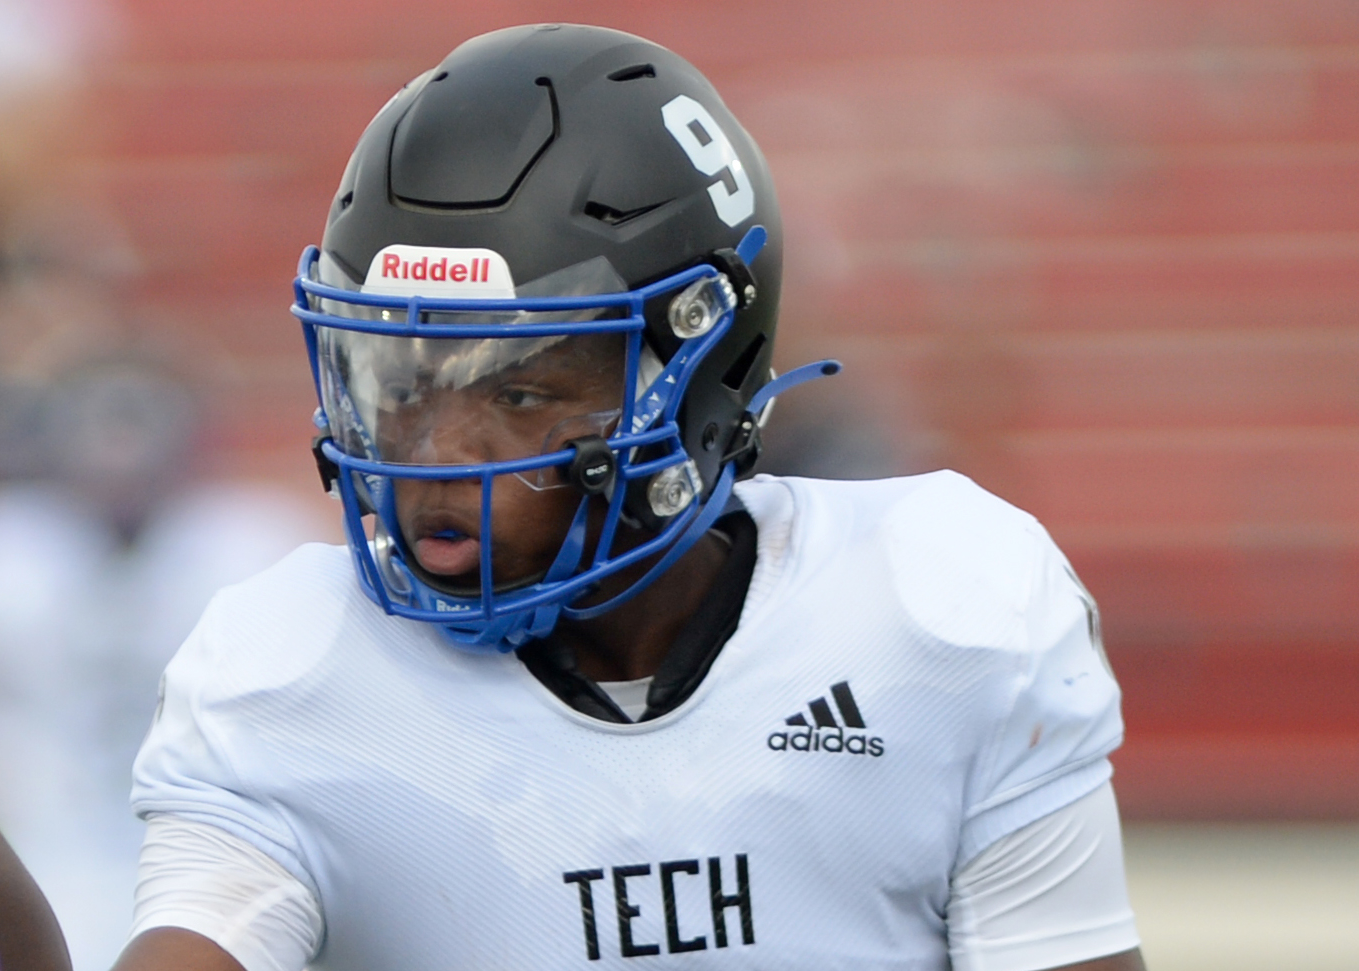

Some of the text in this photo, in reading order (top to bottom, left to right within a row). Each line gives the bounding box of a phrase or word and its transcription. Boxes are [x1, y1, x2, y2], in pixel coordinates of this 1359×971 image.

[660, 93, 755, 228] 9
[382, 252, 490, 283] Riddell
[767, 724, 885, 757] adidas
[562, 852, 756, 962] TECH
